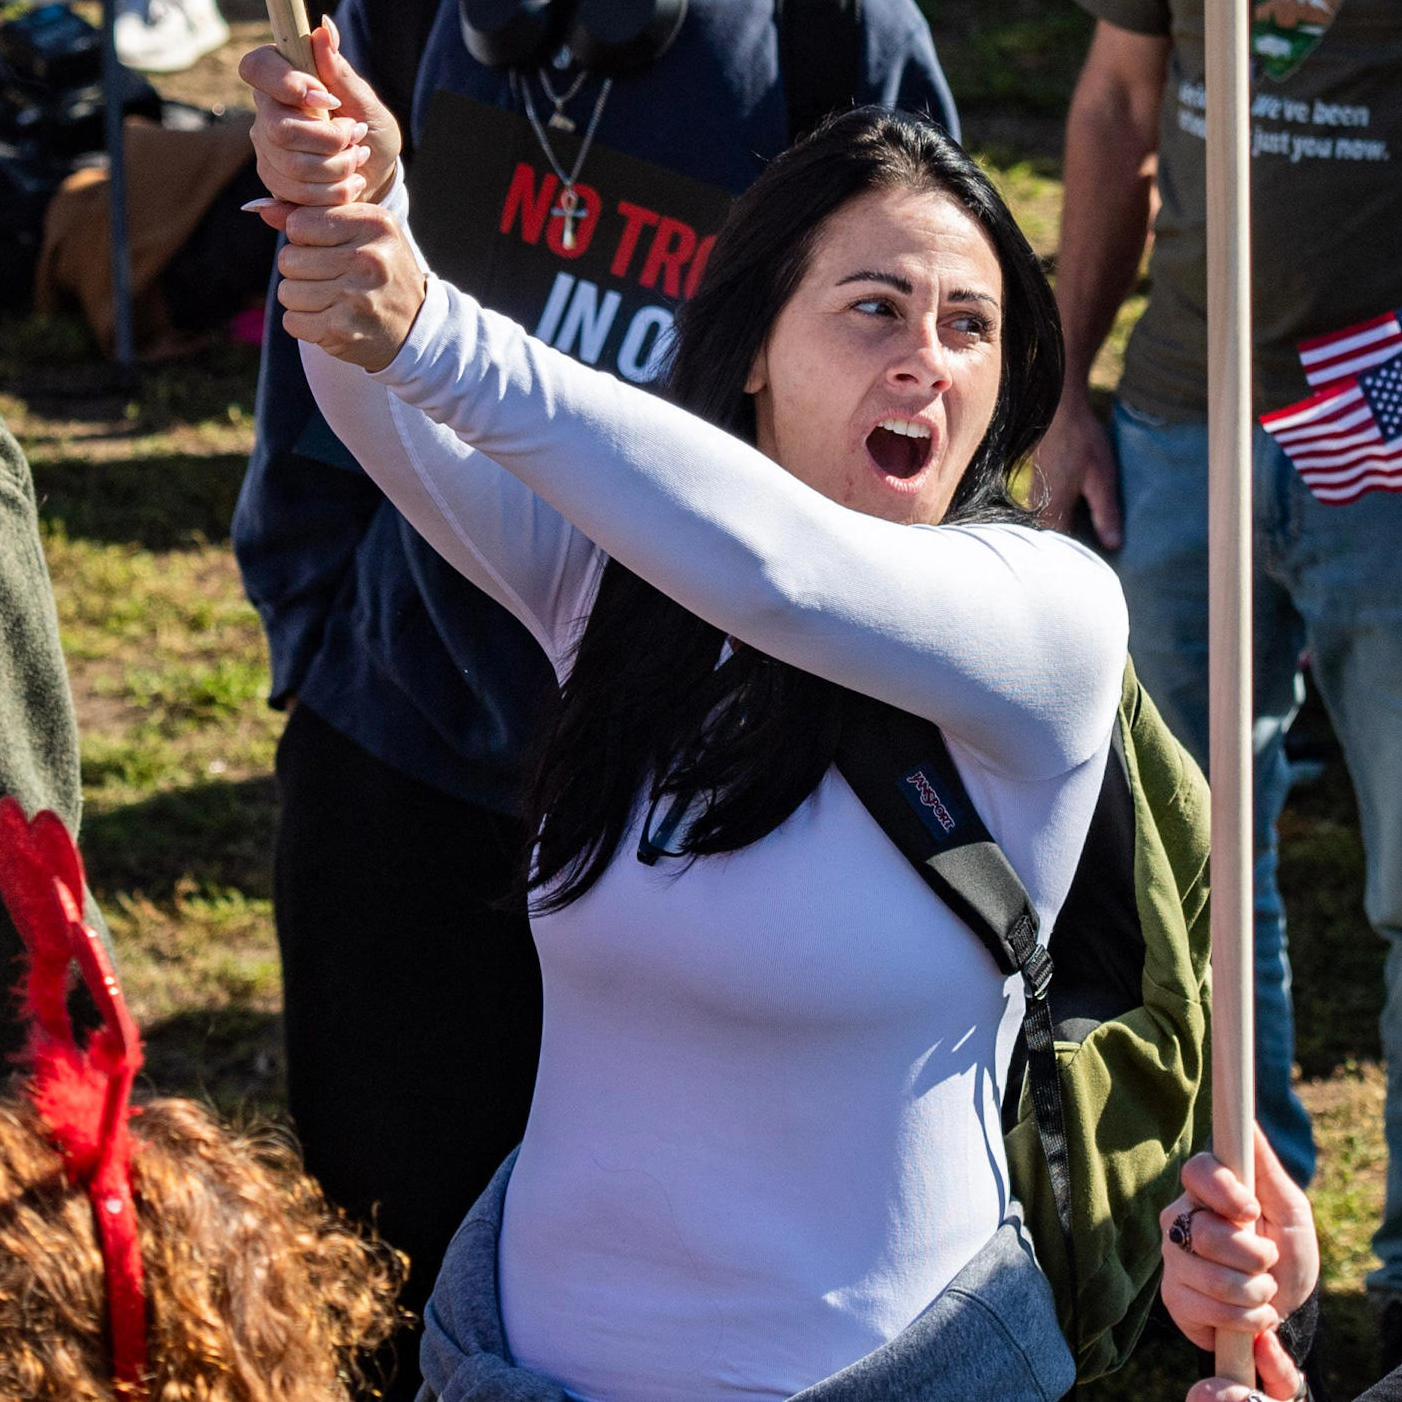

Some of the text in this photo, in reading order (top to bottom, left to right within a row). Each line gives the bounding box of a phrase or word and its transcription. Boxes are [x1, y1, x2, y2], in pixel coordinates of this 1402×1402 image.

[1312, 99, 1370, 128] been
[1250, 125, 1391, 165] just you now.
[499, 161, 603, 259] NO
[535, 270, 623, 365] IN
[906, 770, 956, 831] JANSPORT
